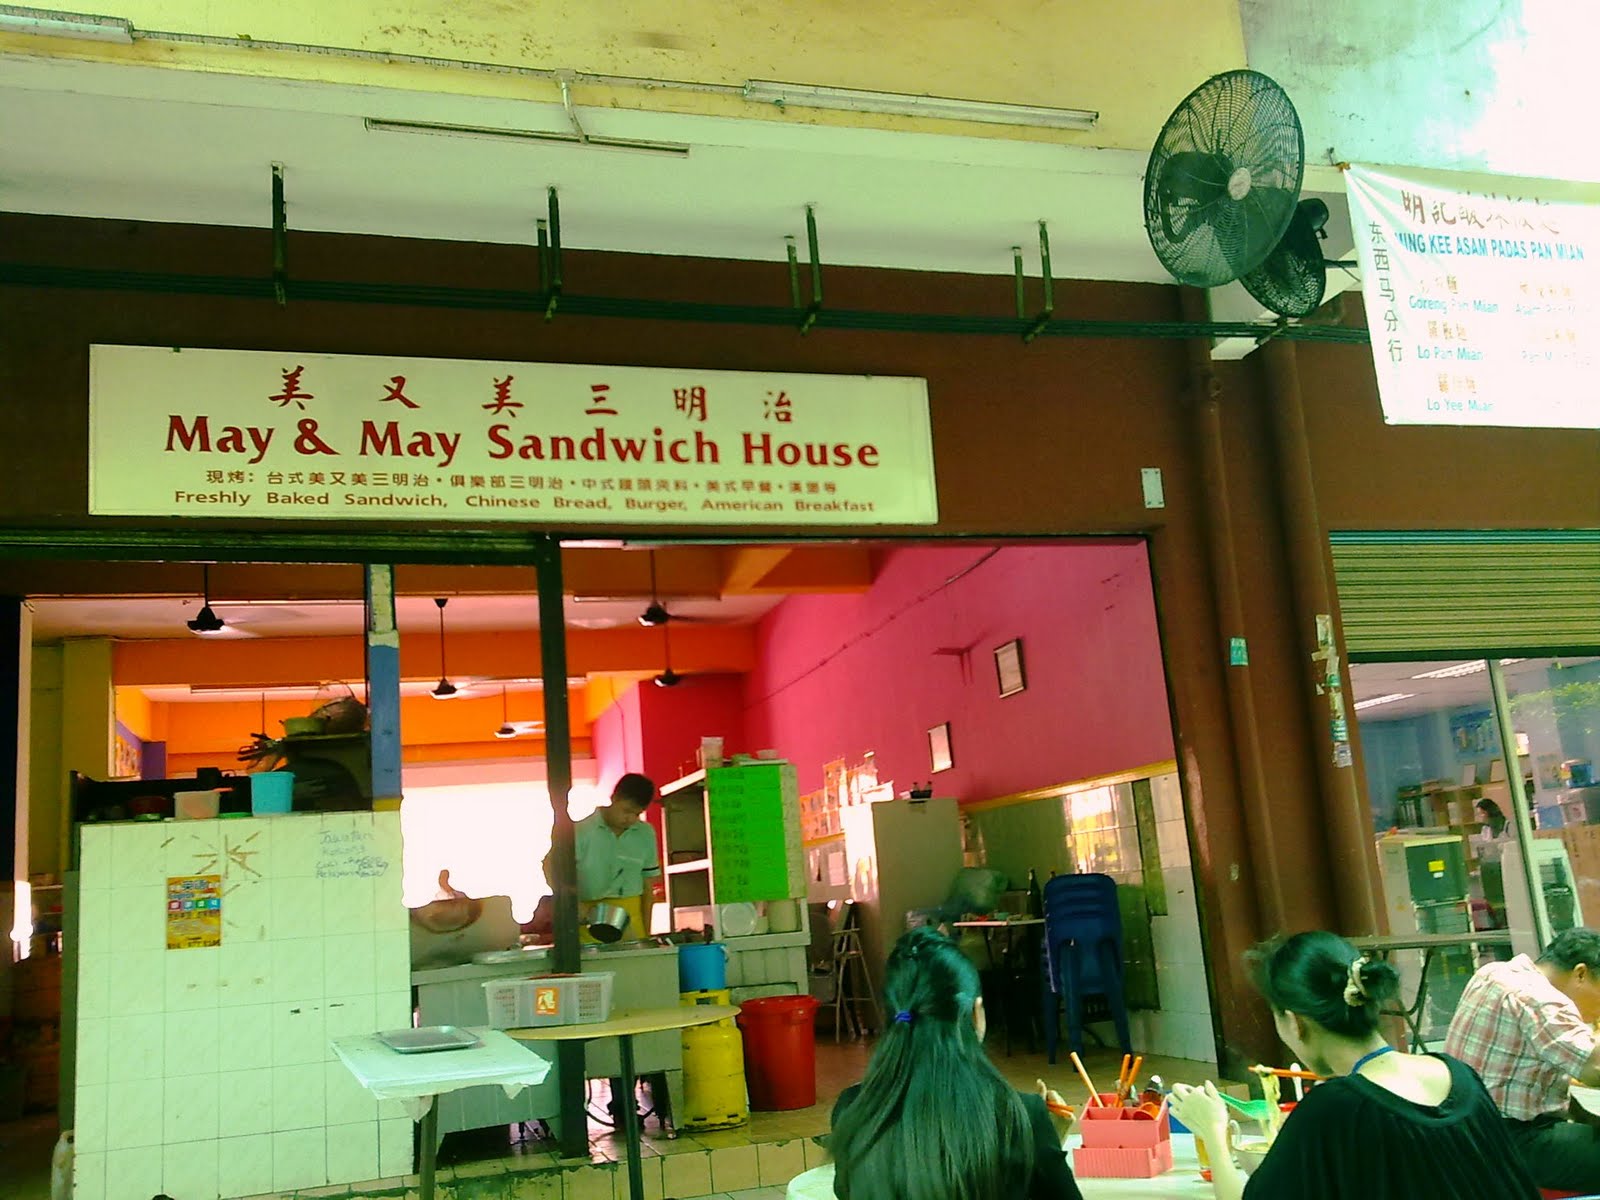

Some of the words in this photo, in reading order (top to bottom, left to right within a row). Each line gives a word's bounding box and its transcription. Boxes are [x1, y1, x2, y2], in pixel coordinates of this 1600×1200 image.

[1429, 234, 1453, 254] KEE
[1457, 236, 1489, 256] ASAM
[1491, 239, 1528, 259] PADAS
[1531, 241, 1552, 260] PAN
[1369, 221, 1402, 362] 东西马分行
[1417, 344, 1430, 359] Lo
[268, 365, 793, 422] 美又美三明治
[1427, 398, 1440, 411] Lo
[164, 415, 275, 464] May
[294, 418, 341, 455] &
[359, 420, 461, 467] May
[487, 424, 720, 464] Sandwich
[741, 432, 880, 467] House
[175, 490, 251, 508] Freshly
[267, 491, 330, 506] Baked
[344, 492, 448, 508] Sandwich,
[465, 495, 540, 509] Chinese
[553, 496, 614, 512] Bread,
[626, 499, 688, 513] Burger,
[701, 499, 783, 512] American
[794, 501, 874, 513] Breakfast
